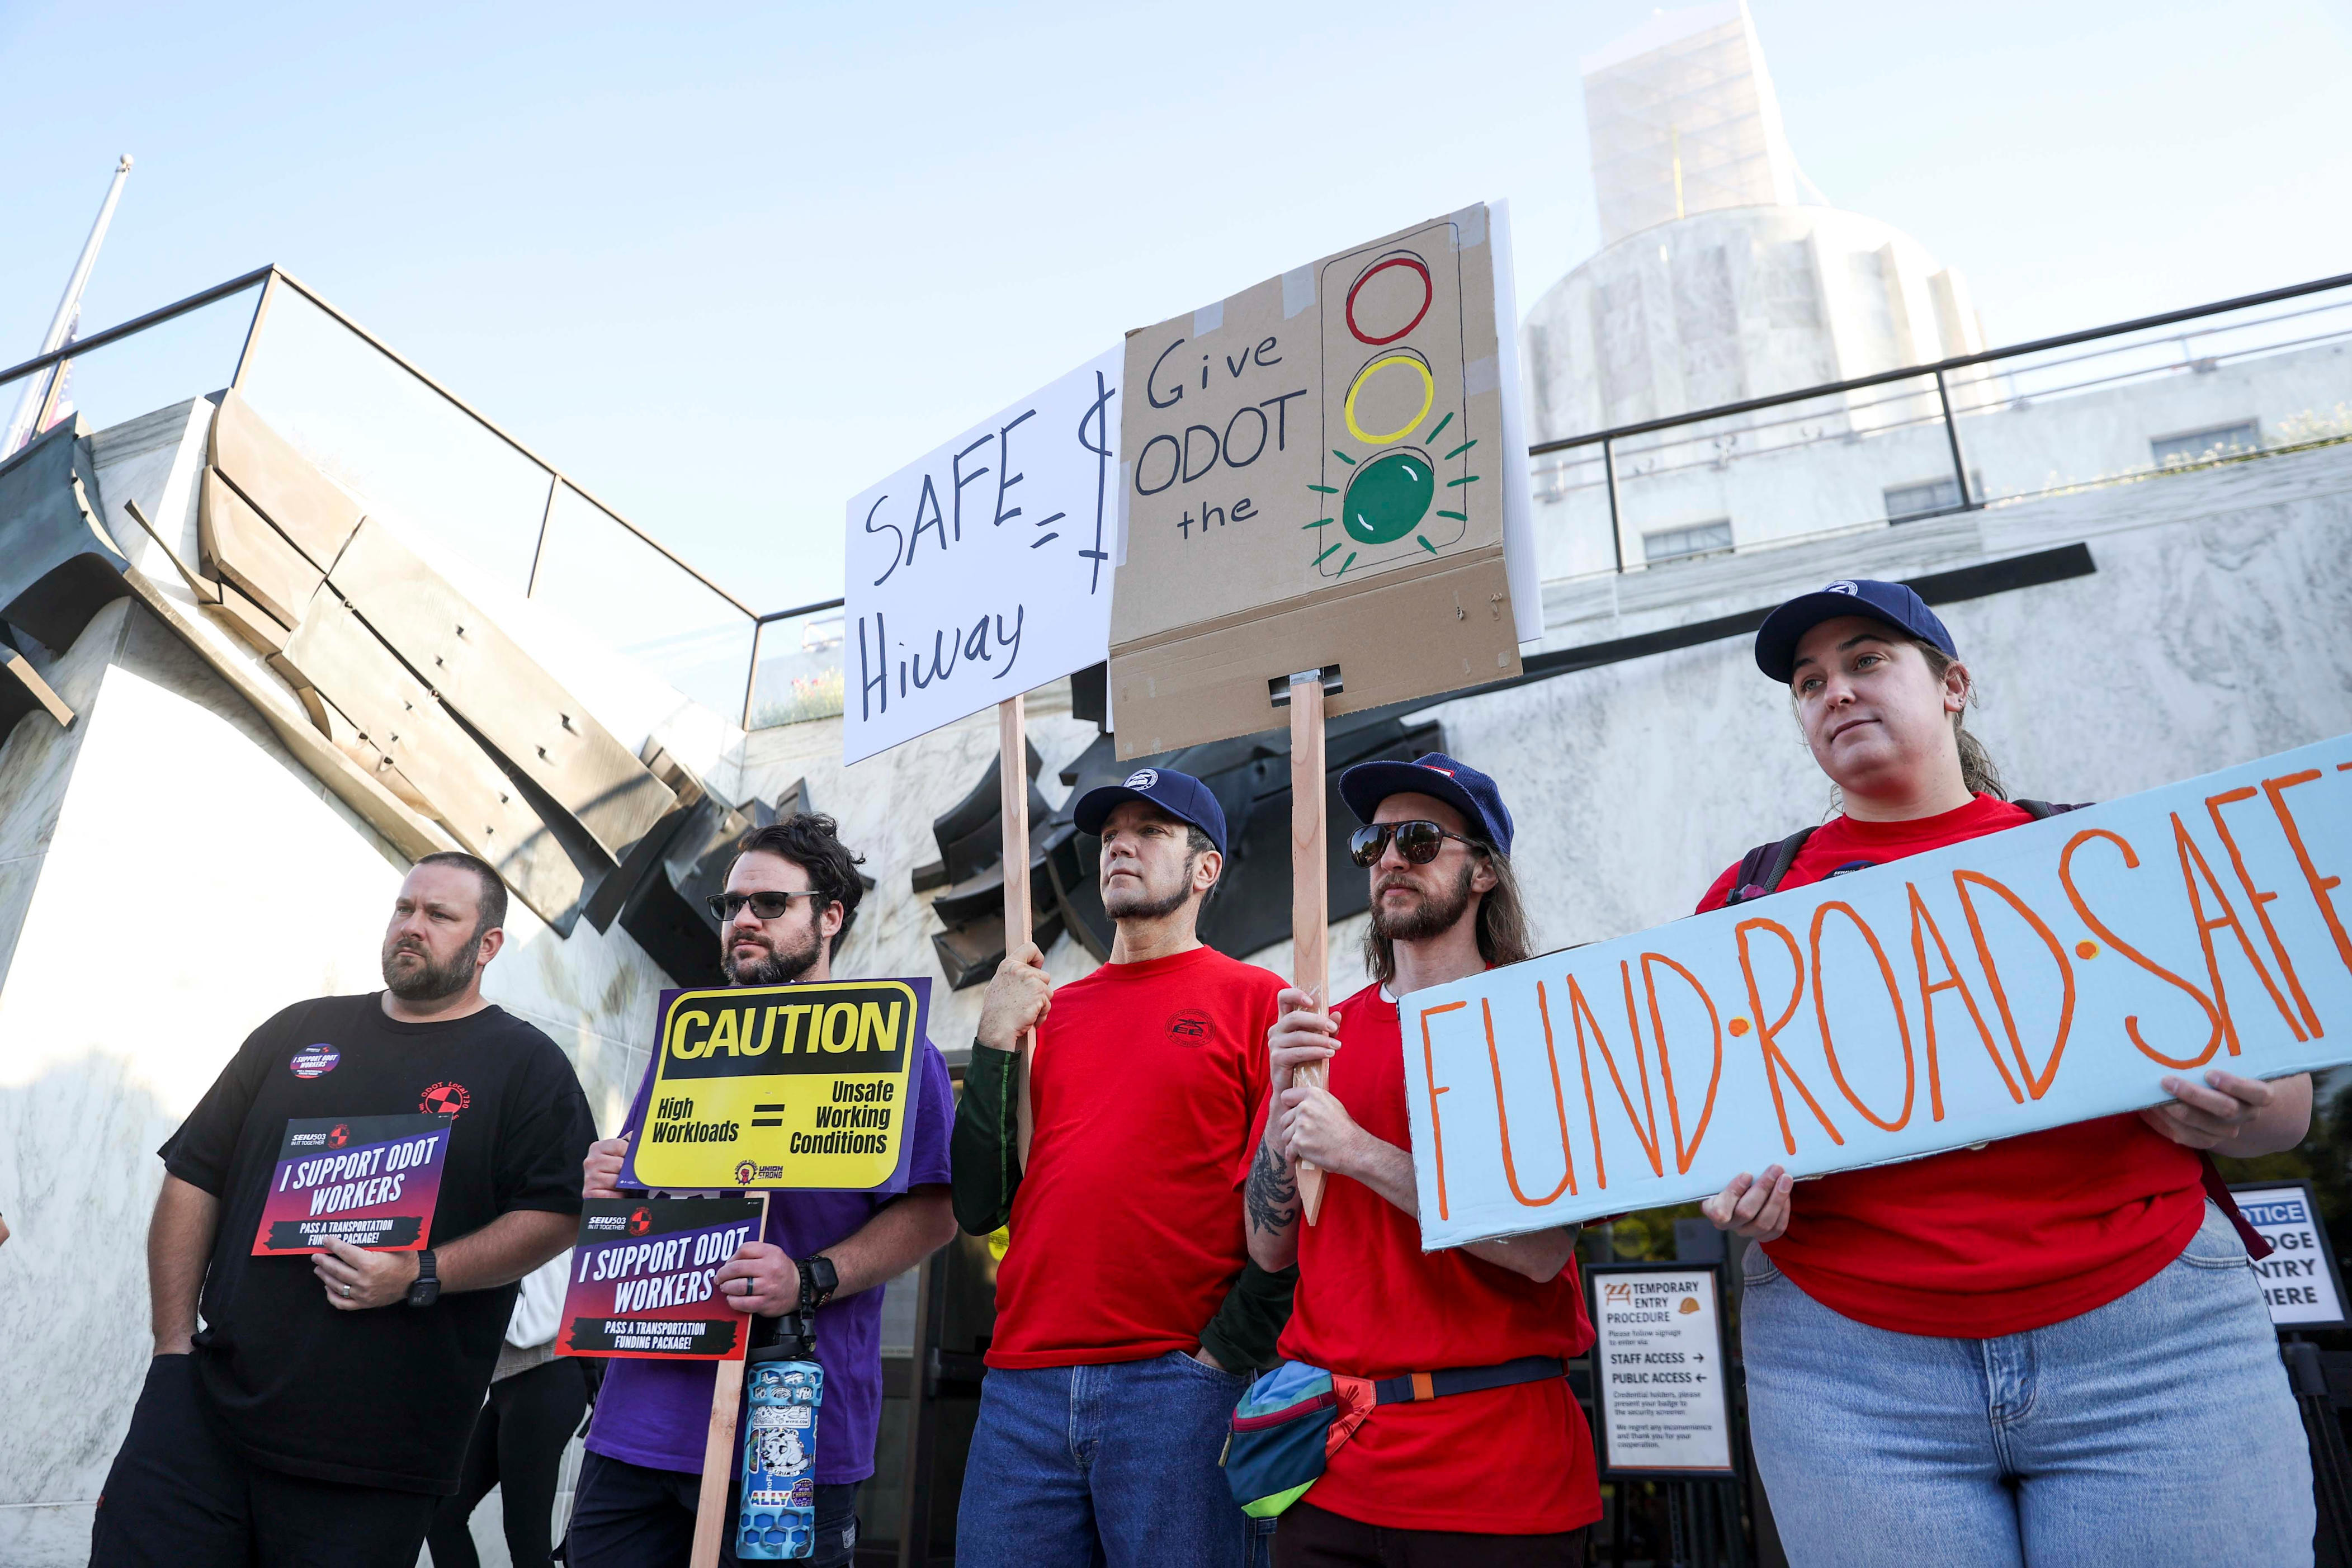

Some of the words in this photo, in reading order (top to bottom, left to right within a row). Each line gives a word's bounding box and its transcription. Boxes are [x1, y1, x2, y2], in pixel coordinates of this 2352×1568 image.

[1147, 337, 1282, 408] Give
[1135, 389, 1307, 495] ODOT
[866, 409, 1036, 586] SAFE
[1177, 497, 1258, 540] the
[859, 603, 1023, 722] Hiway
[672, 1001, 902, 1060] CAUTION
[421, 1081, 443, 1097] ODOT
[448, 1081, 469, 1094] Local
[462, 1094, 470, 1108] 730
[832, 1079, 894, 1102] Unsafe
[657, 1097, 694, 1120] High
[816, 1104, 891, 1130] Working
[652, 1120, 740, 1143] Workloads
[790, 1131, 887, 1154] Conditions
[279, 1165, 292, 1192] I
[292, 1147, 385, 1189] SUPPORT
[386, 1136, 439, 1172] ODOT
[309, 1173, 405, 1216] WORKERS
[299, 1222, 320, 1234] PASS
[320, 1222, 327, 1233] A
[329, 1219, 394, 1233] TRANSPORTATION
[343, 1232, 380, 1244] PACKAGE!
[578, 1252, 591, 1283] I
[593, 1236, 692, 1282] SUPPORT
[693, 1226, 749, 1267] ODOT
[2251, 1258, 2316, 1278] NTRY
[614, 1268, 716, 1314] WORKERS
[1633, 1281, 1699, 1294] TEMPORARY
[1635, 1297, 1669, 1309] ENTRY
[604, 1321, 627, 1334] PASS
[627, 1321, 634, 1334] A
[636, 1322, 706, 1335] TRANSPORTATION
[1607, 1311, 1670, 1323] PROCEDURE
[614, 1335, 651, 1349] FUNDING
[652, 1336, 692, 1349] PACKAGE!
[1610, 1353, 1641, 1364] STAFF
[1644, 1352, 1685, 1364] ACCESS
[1612, 1372, 1649, 1384] PUBLIC
[1651, 1372, 1692, 1383] ACCESS
[751, 1492, 790, 1505] ALLY
